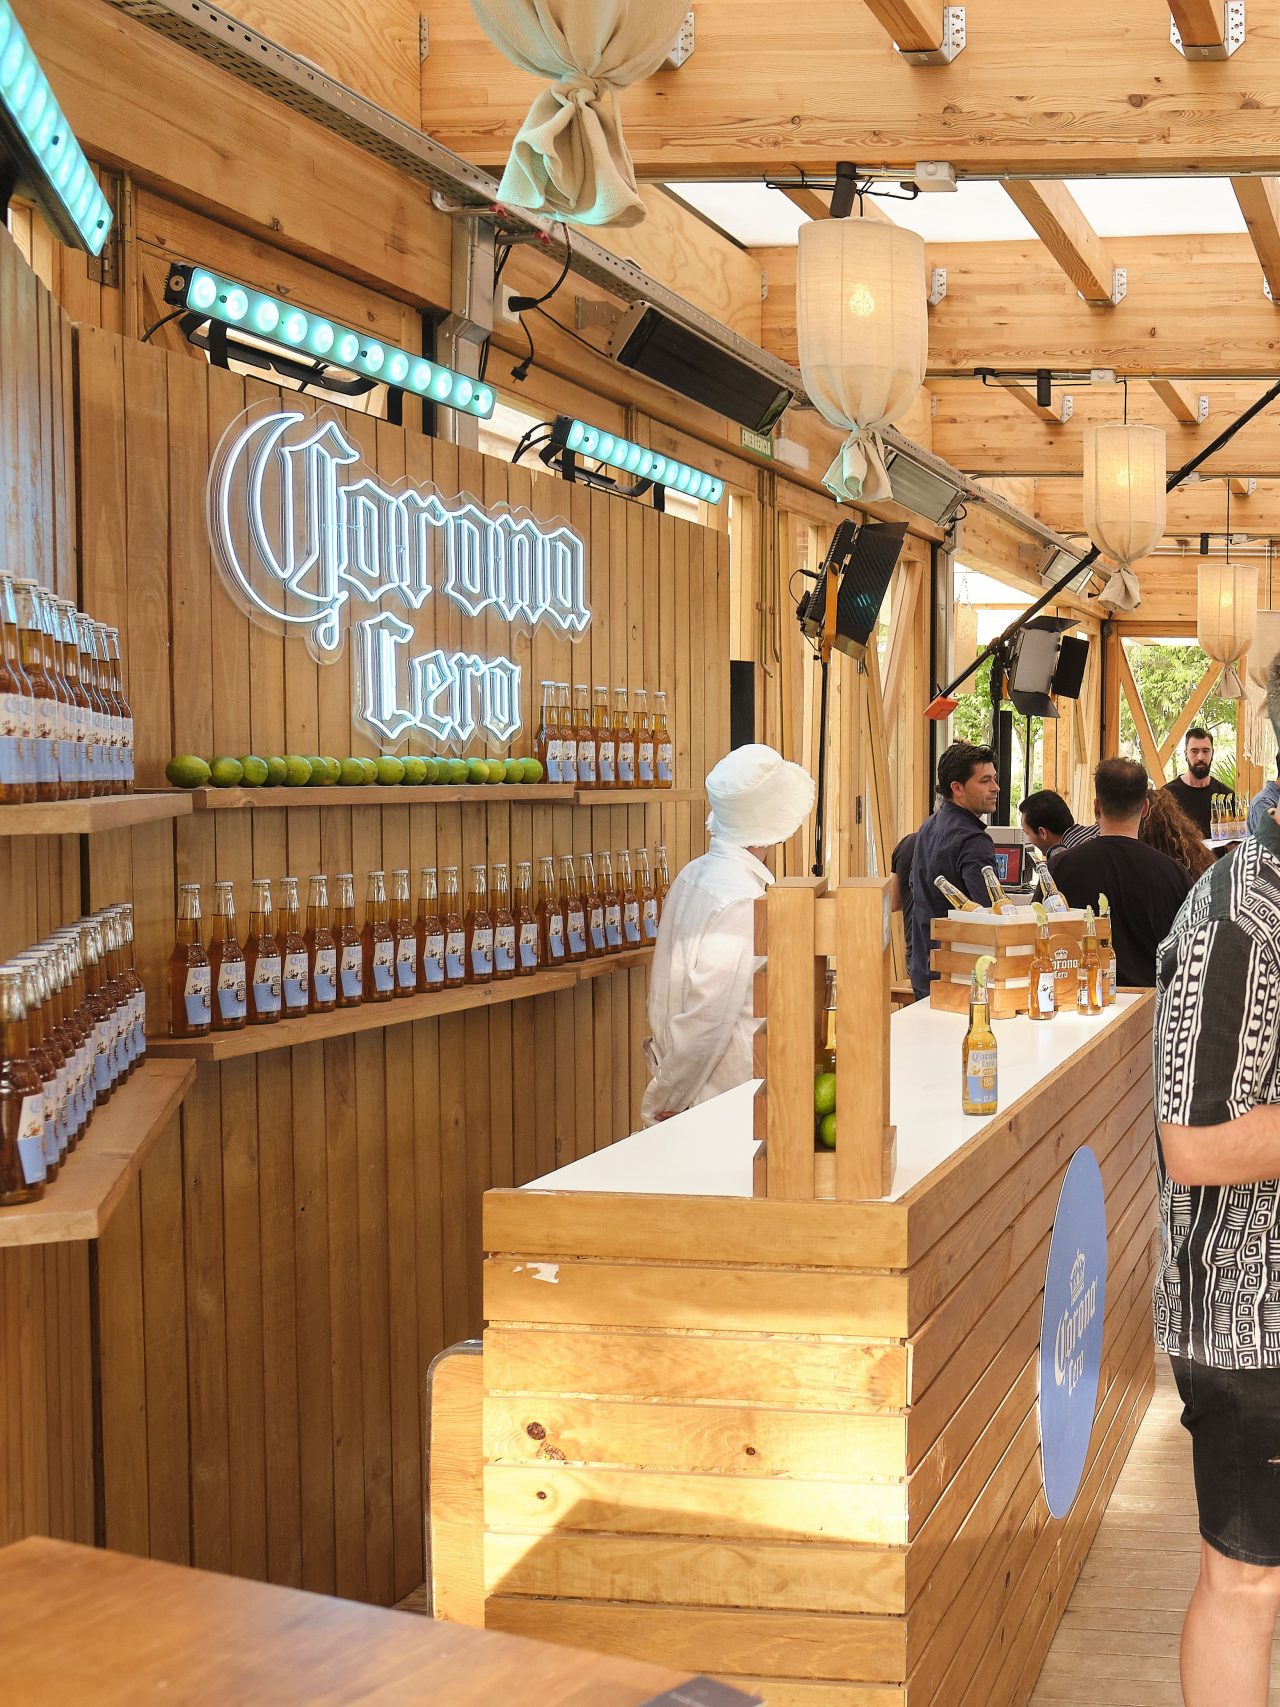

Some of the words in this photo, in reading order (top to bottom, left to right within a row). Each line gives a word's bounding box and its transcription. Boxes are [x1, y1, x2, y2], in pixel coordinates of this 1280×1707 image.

[222, 412, 591, 650] Corona
[362, 611, 521, 741] Cero
[1050, 959, 1077, 970] orona
[1054, 1279, 1096, 1386] Corona
